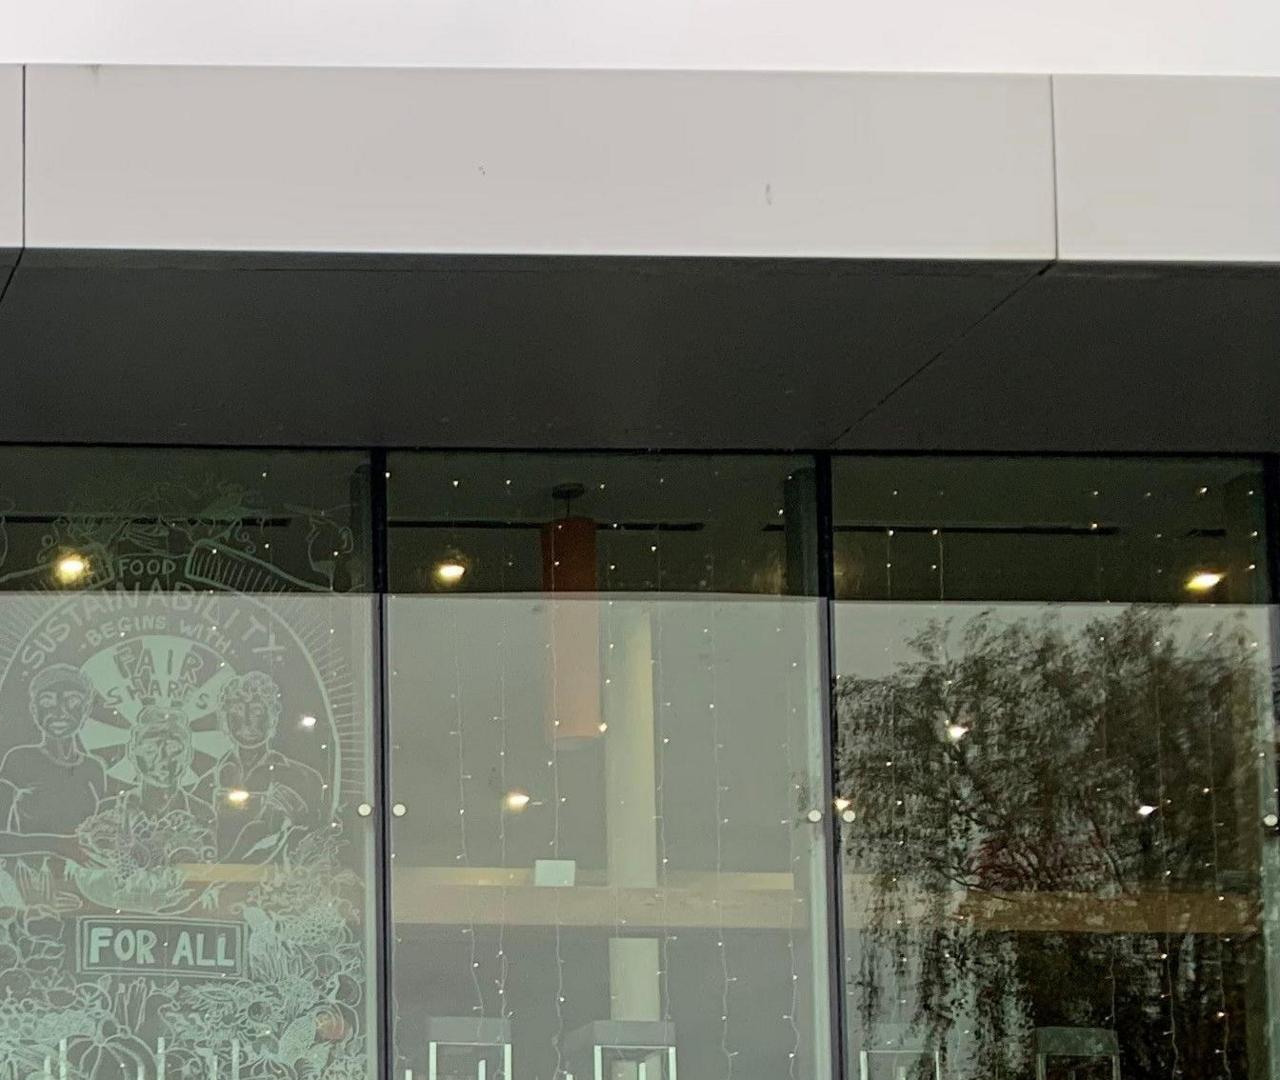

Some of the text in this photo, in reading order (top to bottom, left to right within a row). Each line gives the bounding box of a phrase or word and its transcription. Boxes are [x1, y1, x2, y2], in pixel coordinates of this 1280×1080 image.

[118, 558, 177, 577] FOOD
[21, 577, 286, 670] SUSTAINABILITY
[86, 615, 233, 654] BEGINS WITH
[112, 648, 205, 685] FAIR
[89, 927, 235, 968] FOR ALL
